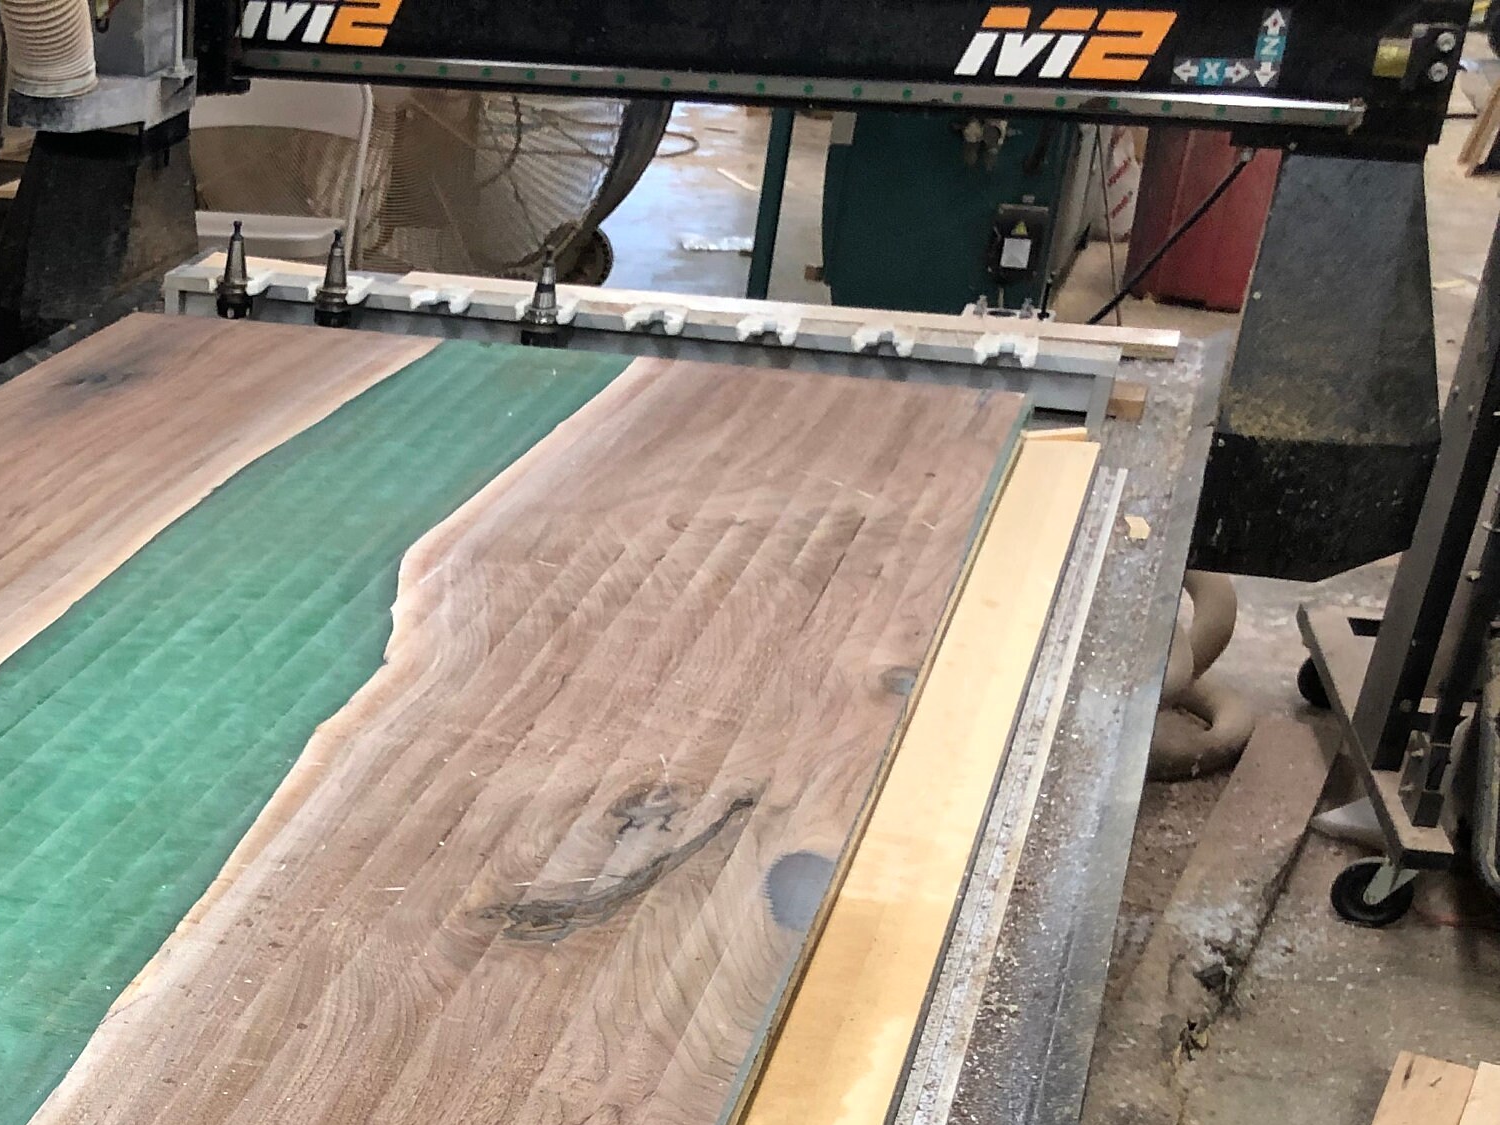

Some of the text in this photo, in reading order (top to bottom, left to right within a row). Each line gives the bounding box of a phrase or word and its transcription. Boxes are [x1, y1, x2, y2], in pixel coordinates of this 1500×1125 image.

[953, 5, 1178, 81] M2
[1260, 36, 1280, 55] Z
[1202, 62, 1220, 80] X
